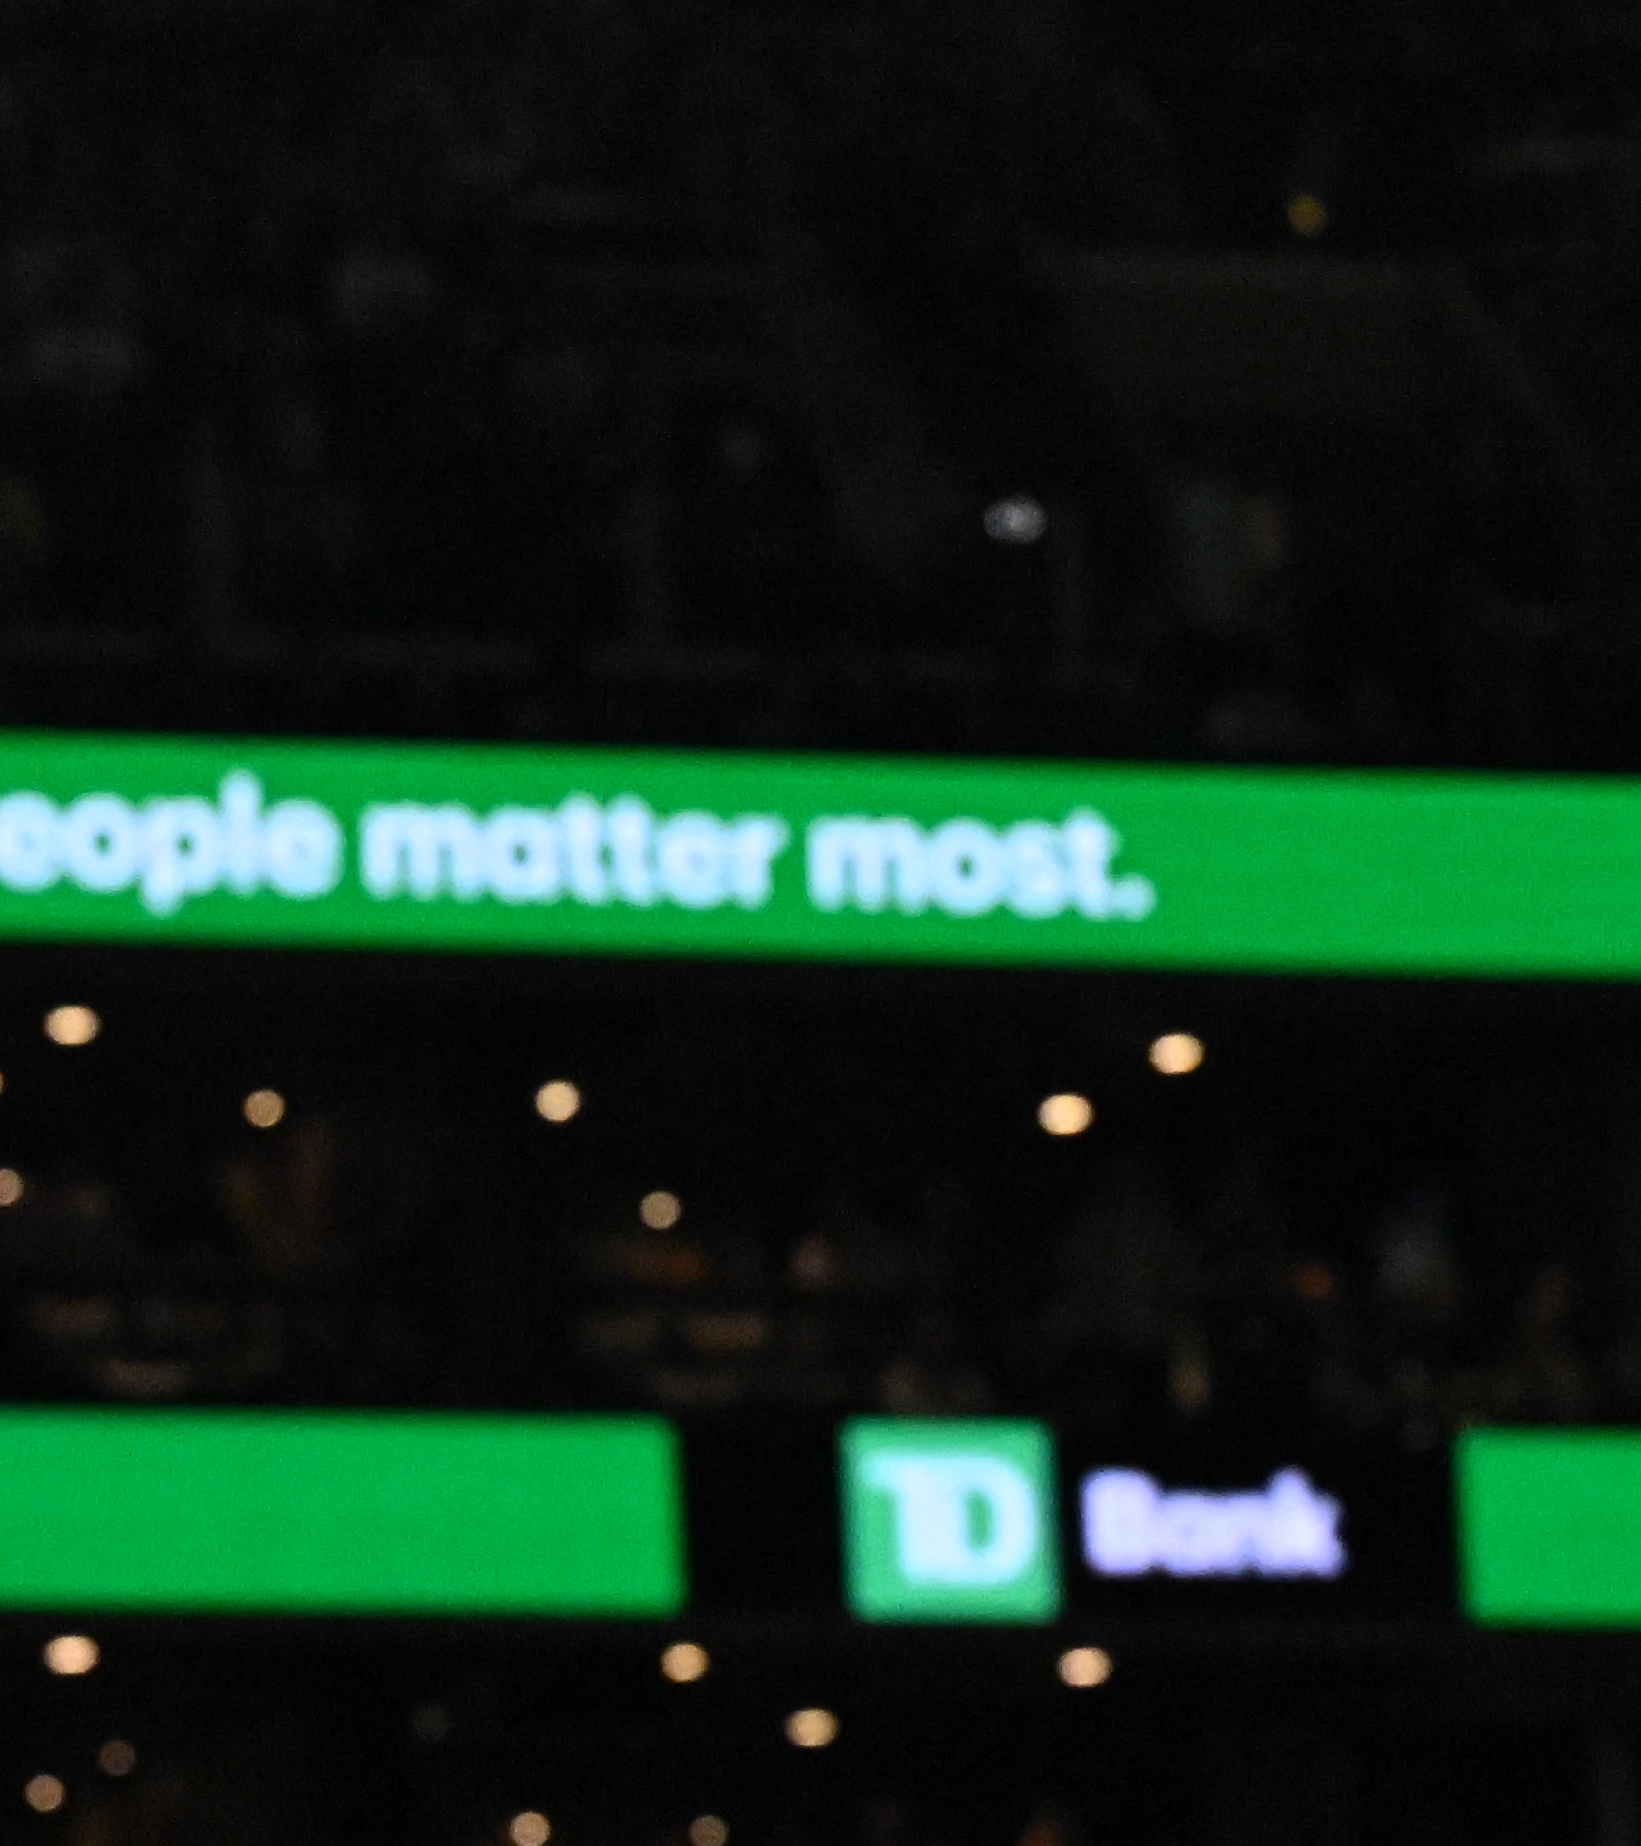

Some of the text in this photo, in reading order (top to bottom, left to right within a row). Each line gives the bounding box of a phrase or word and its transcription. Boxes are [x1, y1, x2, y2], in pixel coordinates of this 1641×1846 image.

[358, 793, 791, 910] matter
[805, 807, 1156, 921] most.
[861, 1450, 1040, 1588] TD
